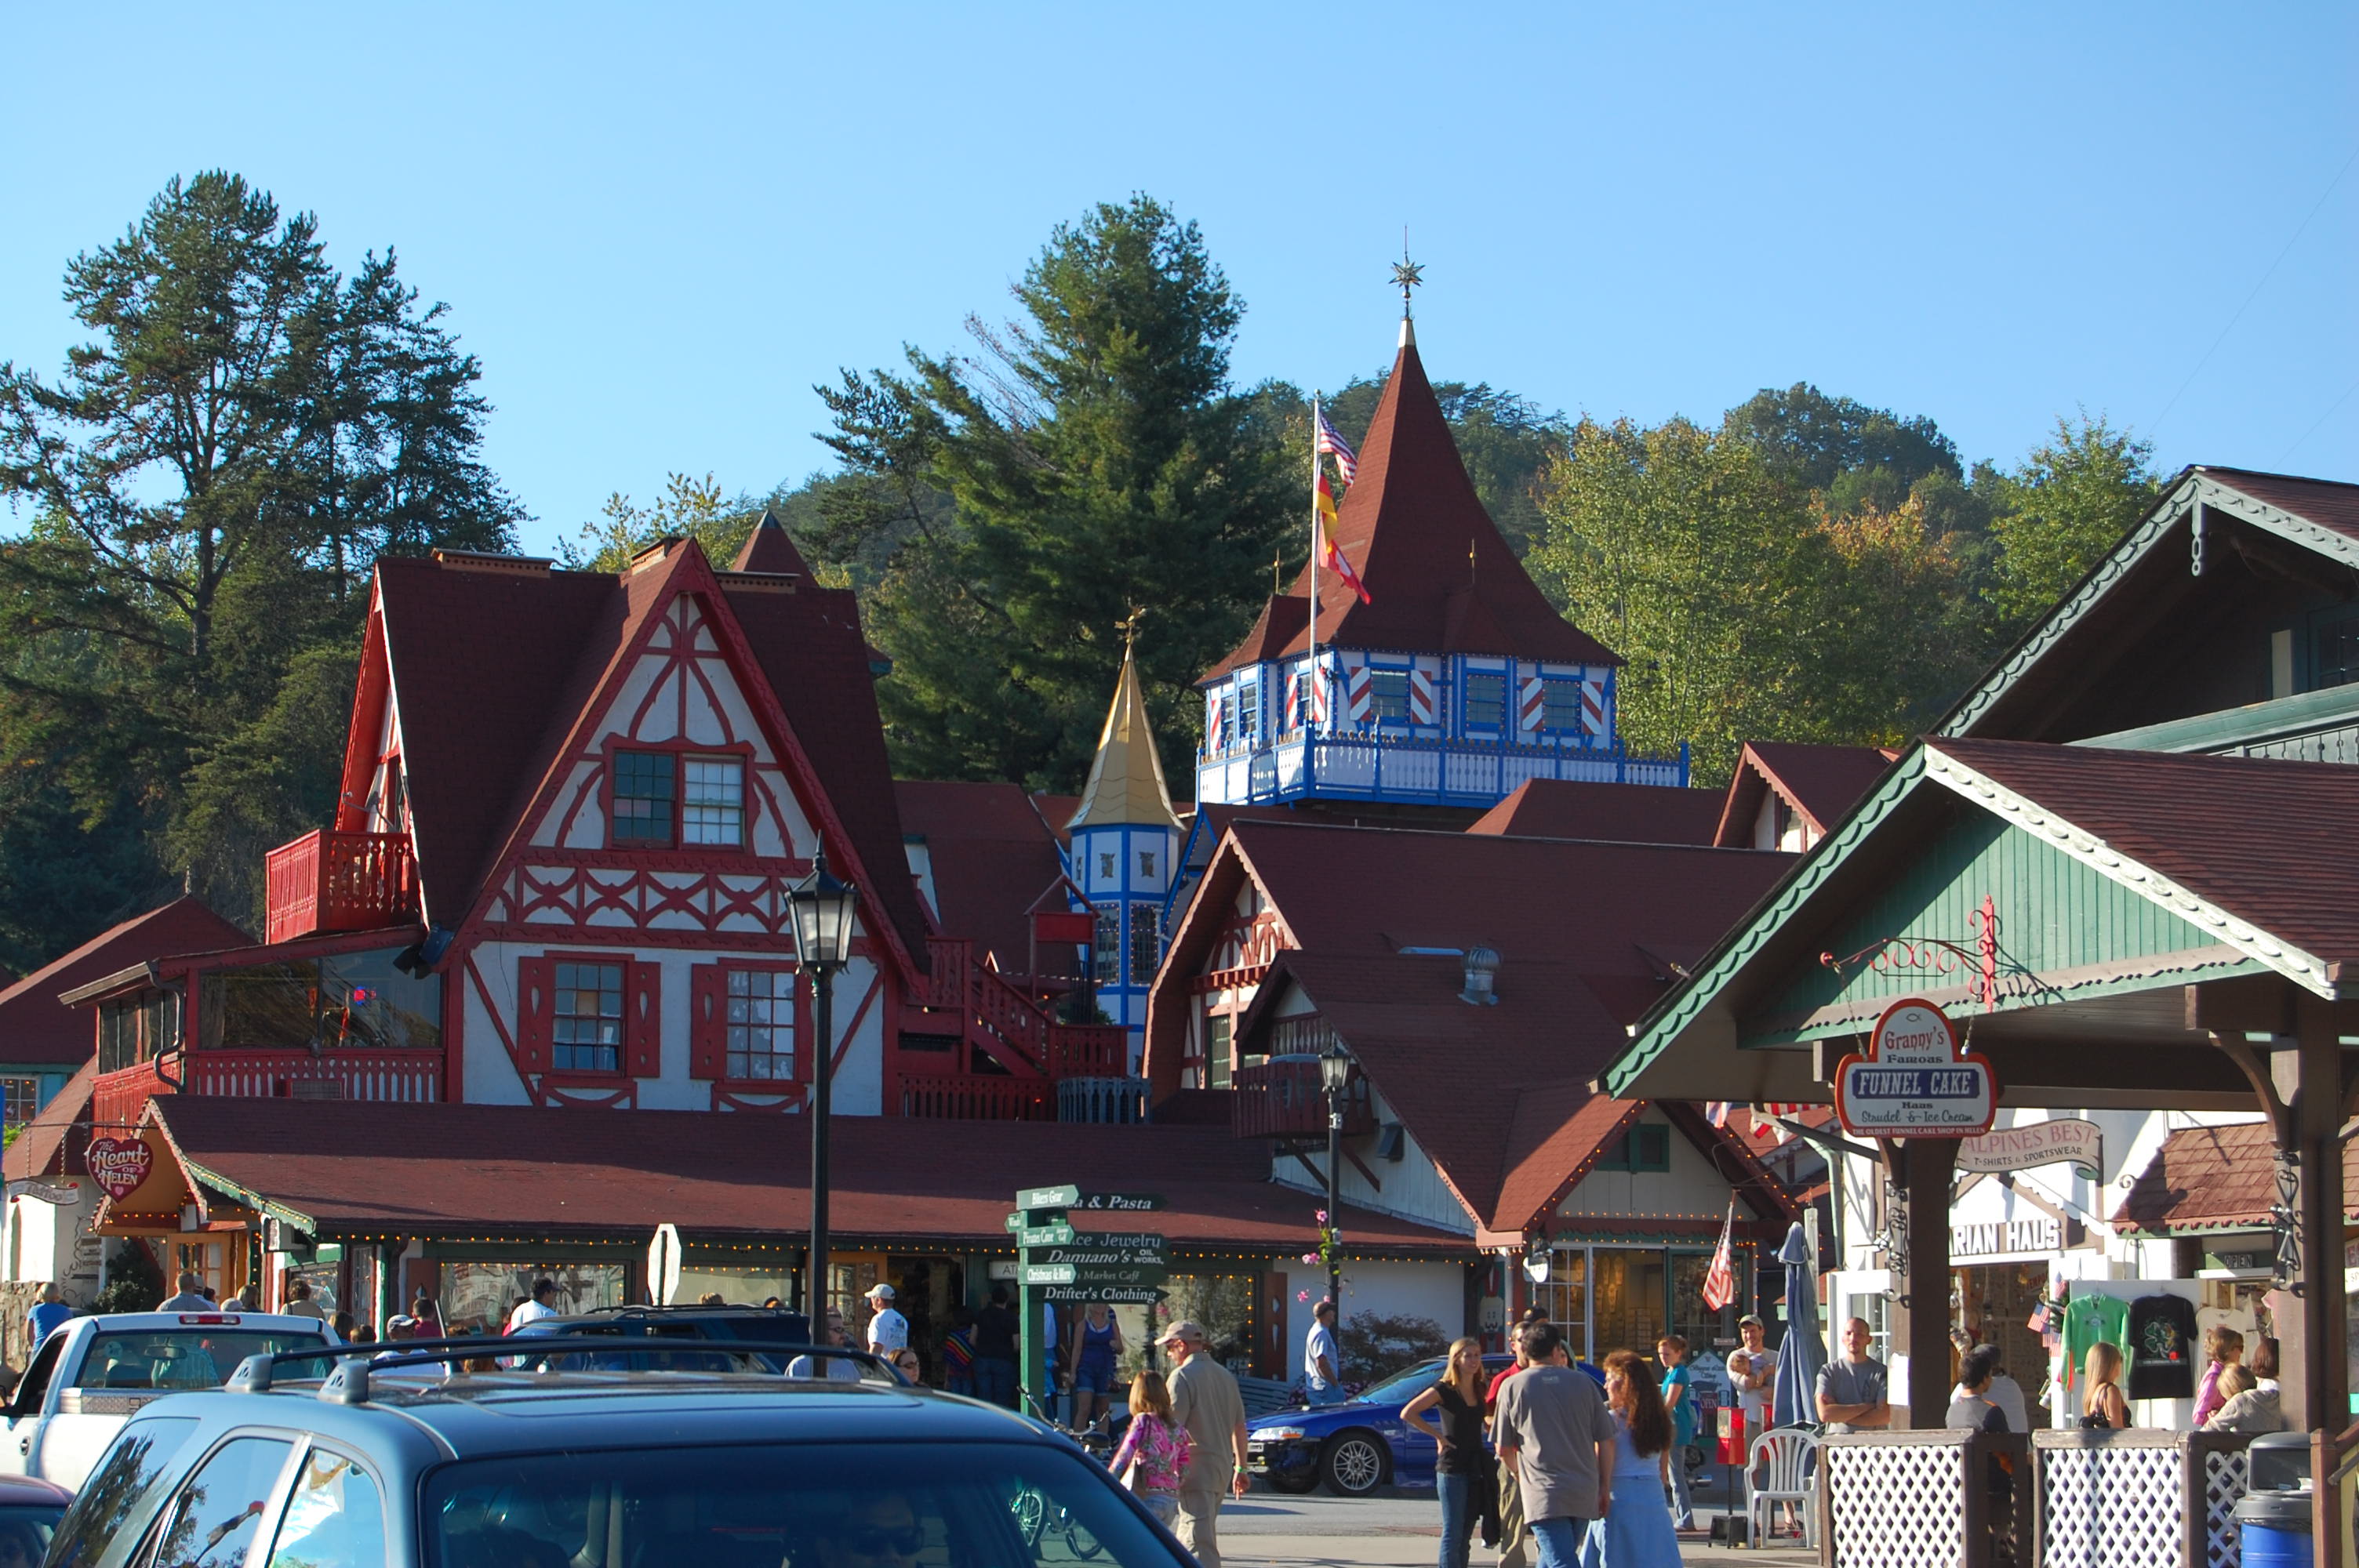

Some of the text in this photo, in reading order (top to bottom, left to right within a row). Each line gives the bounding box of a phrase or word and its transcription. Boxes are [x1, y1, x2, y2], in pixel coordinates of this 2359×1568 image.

[1884, 1026, 1945, 1051] Granny's
[1887, 1054, 1943, 1064] Famous
[1858, 1071, 1972, 1095] FUNNEL CAKE
[1862, 1109, 1975, 1123] Strudel & Ice Cream
[1964, 1123, 2096, 1153] ALPINES BEST
[99, 1141, 114, 1152] The
[92, 1143, 150, 1173] Heart
[1974, 1156, 2012, 1166] T-SHIRTS
[2023, 1145, 2082, 1163] SPORTSWEAR
[98, 1169, 138, 1190] HELEN
[1088, 1196, 1103, 1209] &
[1108, 1195, 1152, 1210] Pasta
[1100, 1233, 1161, 1249] Jewelry
[2006, 1218, 2062, 1251] HAUS
[1046, 1249, 1130, 1264] Damiano's
[2224, 1254, 2252, 1268] OPEN
[1002, 1266, 1018, 1276] AT
[1084, 1270, 1116, 1280] Market
[1045, 1287, 1157, 1304] Drifter's Clothing
[1700, 1398, 1717, 1409] OPEN
